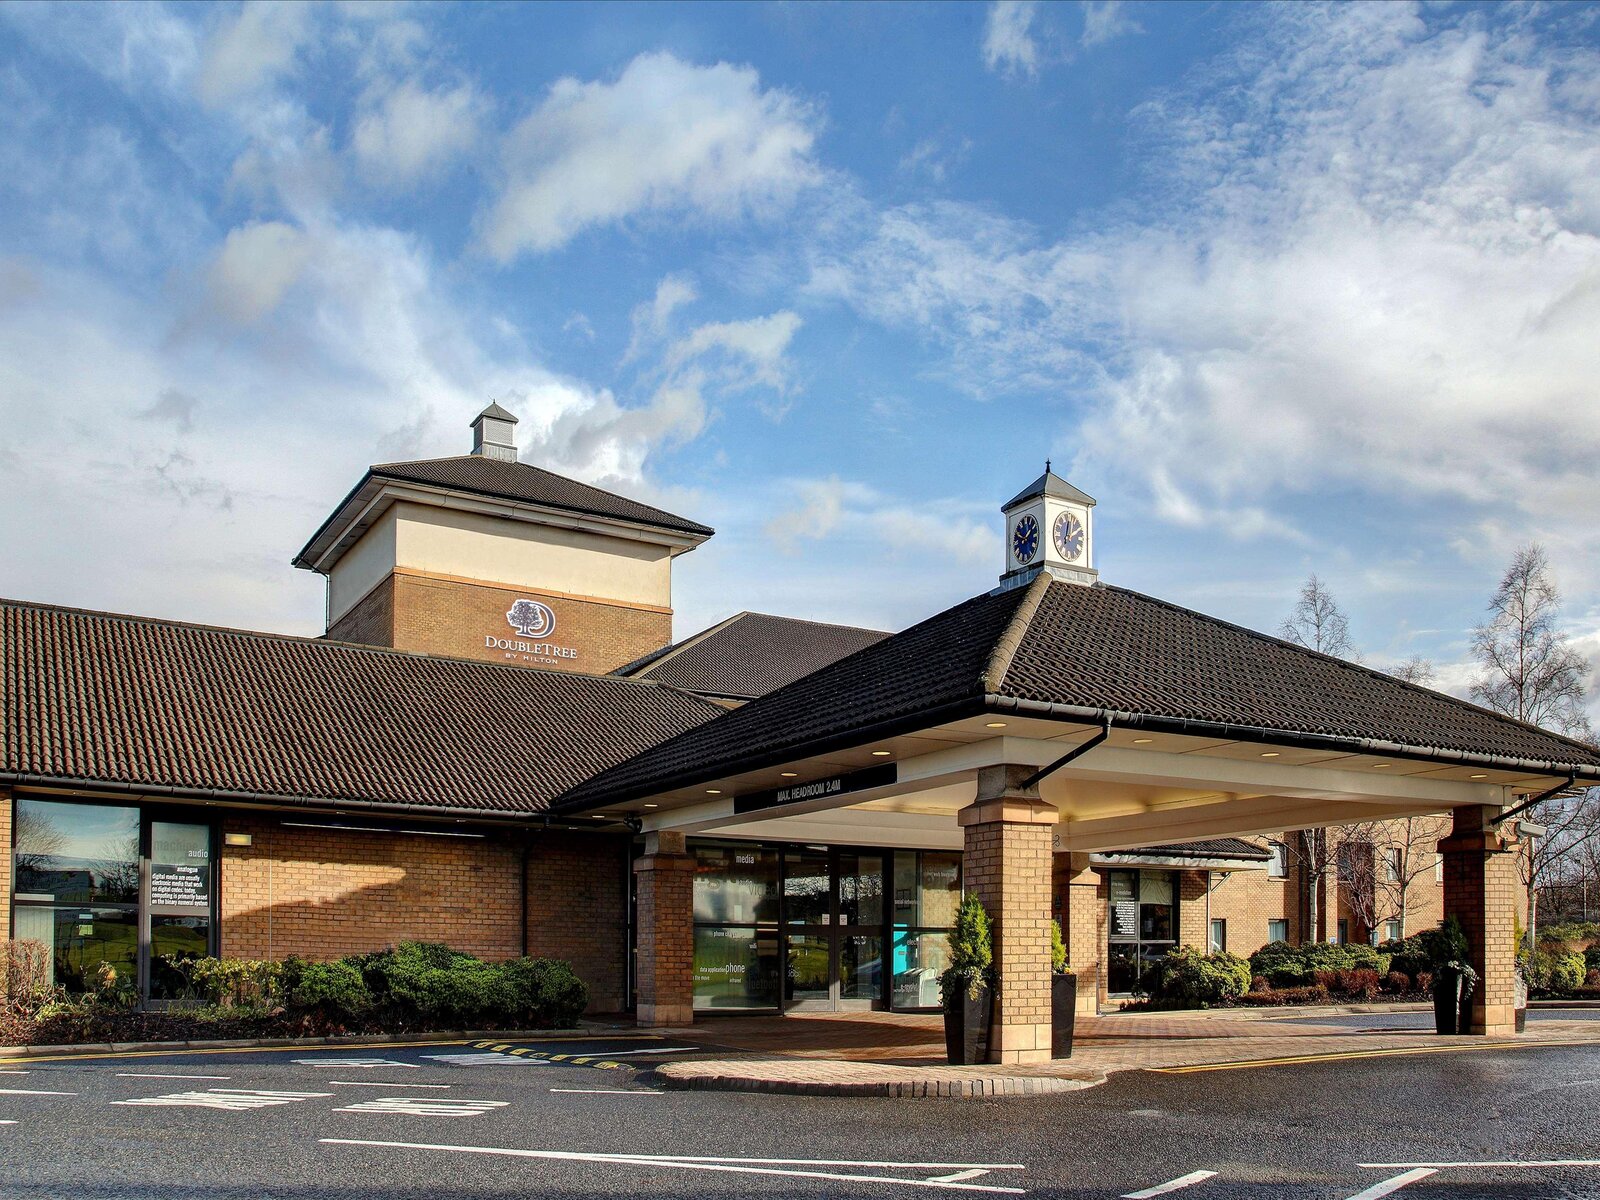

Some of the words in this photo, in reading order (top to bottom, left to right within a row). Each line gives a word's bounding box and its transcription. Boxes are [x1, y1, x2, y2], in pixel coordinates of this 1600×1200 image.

[523, 655, 558, 665] HILTON
[777, 790, 791, 802] MAX.
[791, 782, 825, 800] HEADROOM
[826, 779, 841, 793] 2.4M
[188, 848, 209, 858] audio
[735, 854, 755, 864] media
[725, 962, 746, 975] phone
